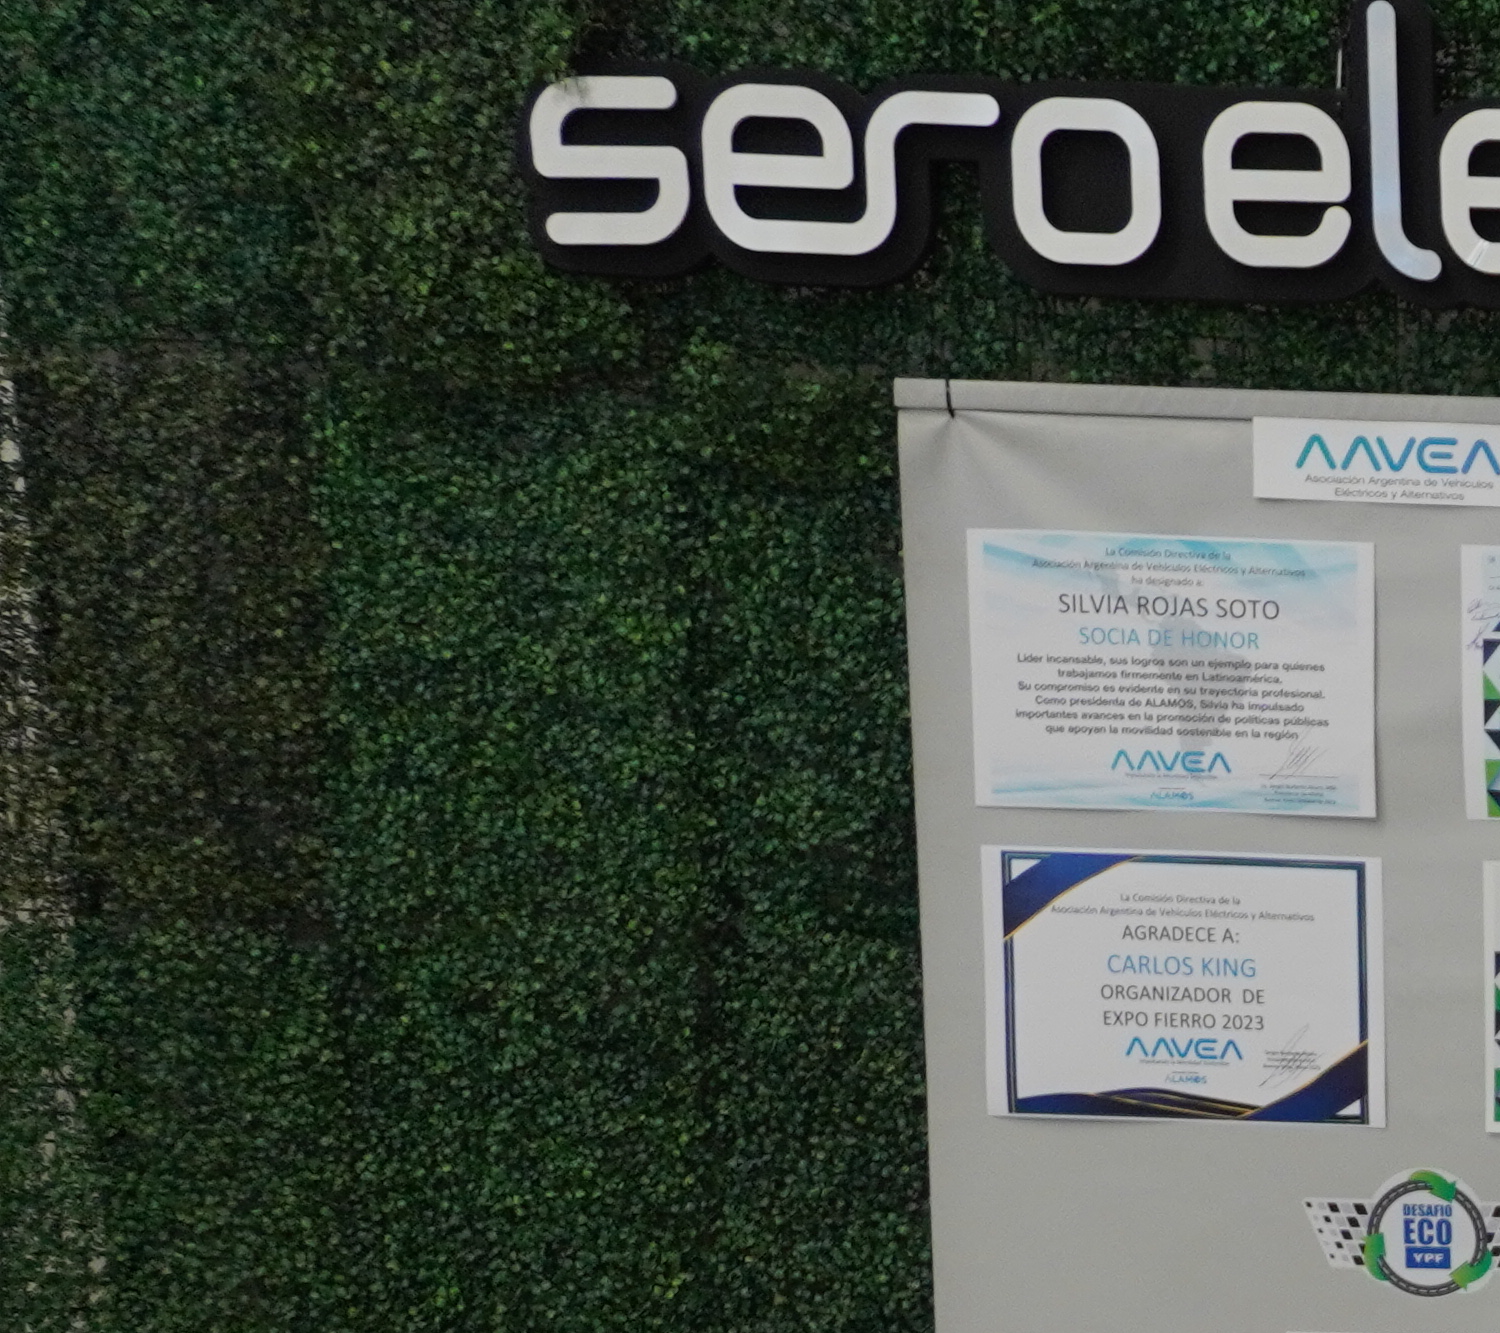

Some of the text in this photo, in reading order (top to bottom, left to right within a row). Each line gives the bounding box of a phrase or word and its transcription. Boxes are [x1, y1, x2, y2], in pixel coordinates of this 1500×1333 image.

[527, 72, 1163, 267] sero
[1058, 592, 1280, 621] SILVIA ROJAS SOTO
[1078, 626, 1260, 650] SOCIA DE HONOR
[1121, 924, 1239, 943] AGRADECE A:
[1107, 954, 1256, 977] CARLOS KING
[1100, 984, 1264, 1004] ORGANIZADOR DE
[1103, 1010, 1264, 1030] EXPO FIERRO 2023
[1403, 1203, 1452, 1217] DESAFIO
[1403, 1218, 1451, 1245] ECO
[1412, 1253, 1444, 1263] YPF
